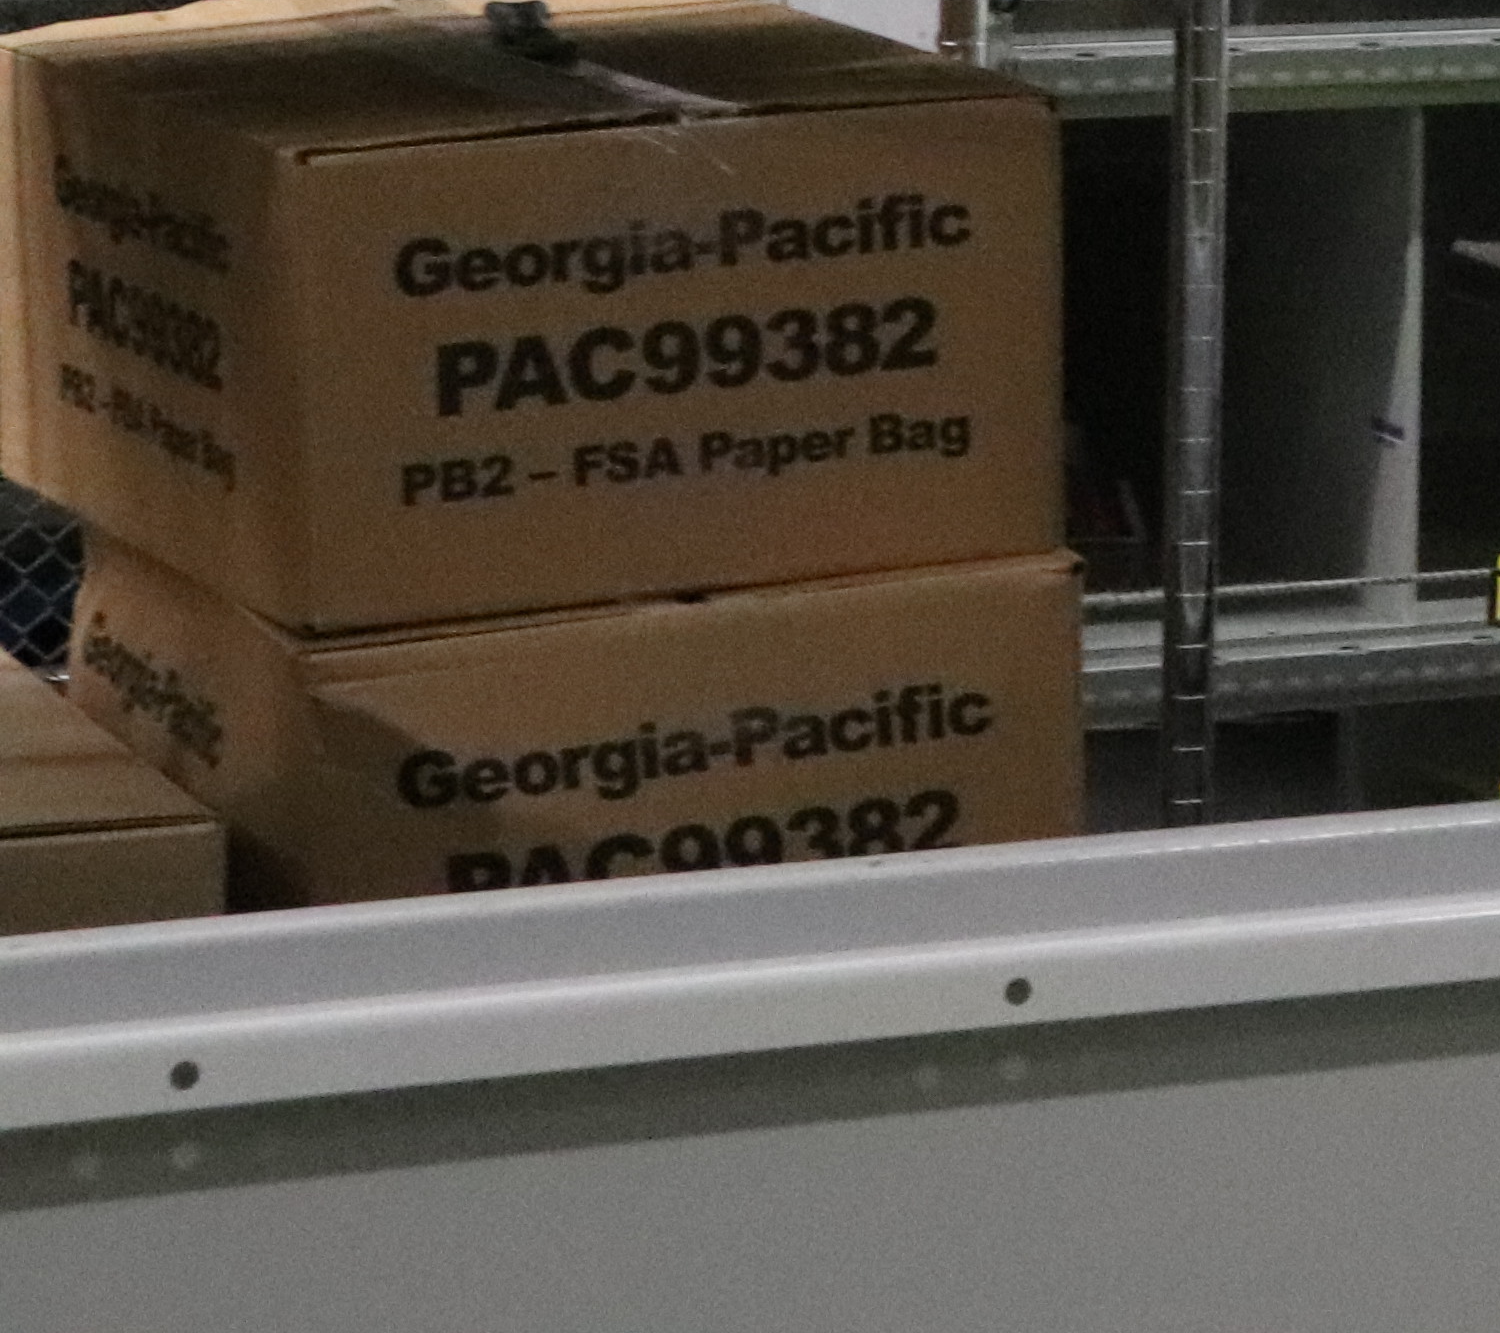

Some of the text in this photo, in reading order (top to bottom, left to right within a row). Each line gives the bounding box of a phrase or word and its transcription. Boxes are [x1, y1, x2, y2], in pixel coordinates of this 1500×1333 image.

[397, 193, 972, 298] Georgia-Pacific
[436, 296, 939, 417] PAC99382
[401, 455, 515, 507] PB2
[571, 436, 684, 488] FSA
[700, 427, 856, 477] Paper
[866, 411, 973, 459] Bag
[399, 682, 993, 810] Georgia-Pacific
[445, 789, 961, 894] PAC99382
